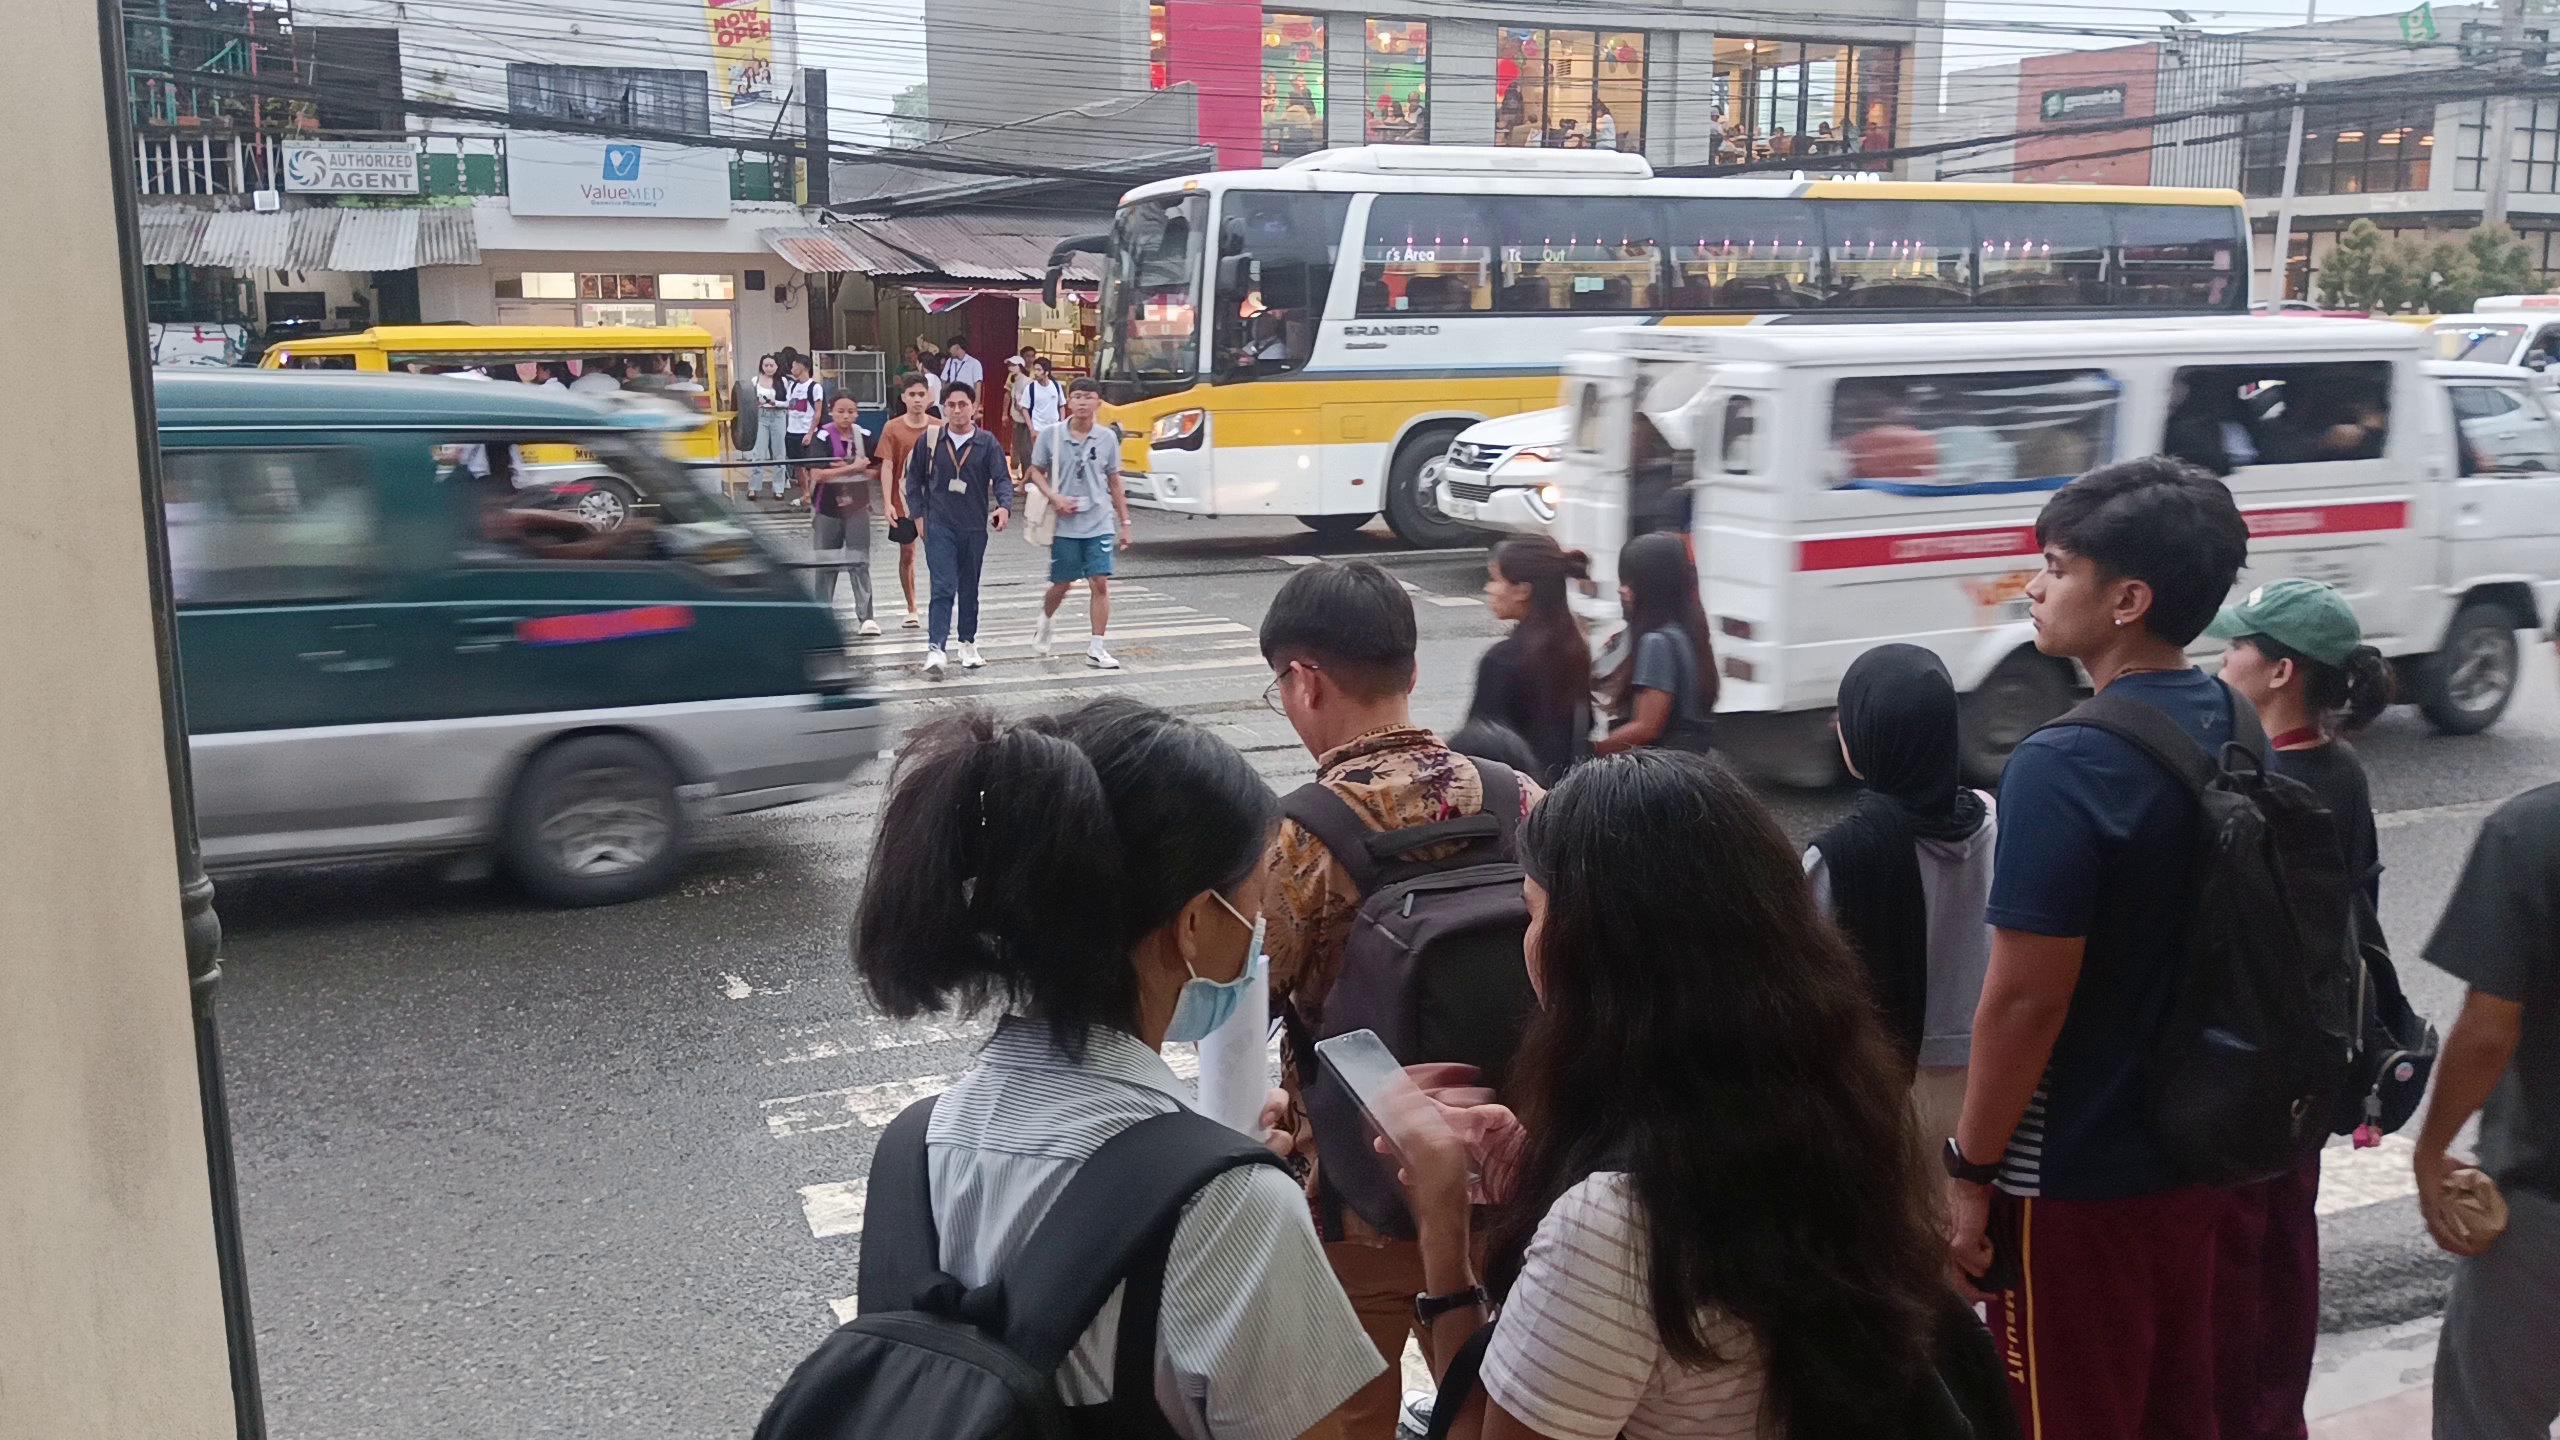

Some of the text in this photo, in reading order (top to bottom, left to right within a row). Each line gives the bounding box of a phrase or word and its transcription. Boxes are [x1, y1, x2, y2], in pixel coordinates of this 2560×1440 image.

[713, 6, 758, 33] NOW
[717, 18, 771, 47] OPEN
[329, 153, 413, 169] AUTHORIZED
[330, 172, 413, 188] AGENT
[580, 184, 665, 201] ValueMED
[1404, 246, 1435, 262] Area
[1542, 248, 1566, 263] Out
